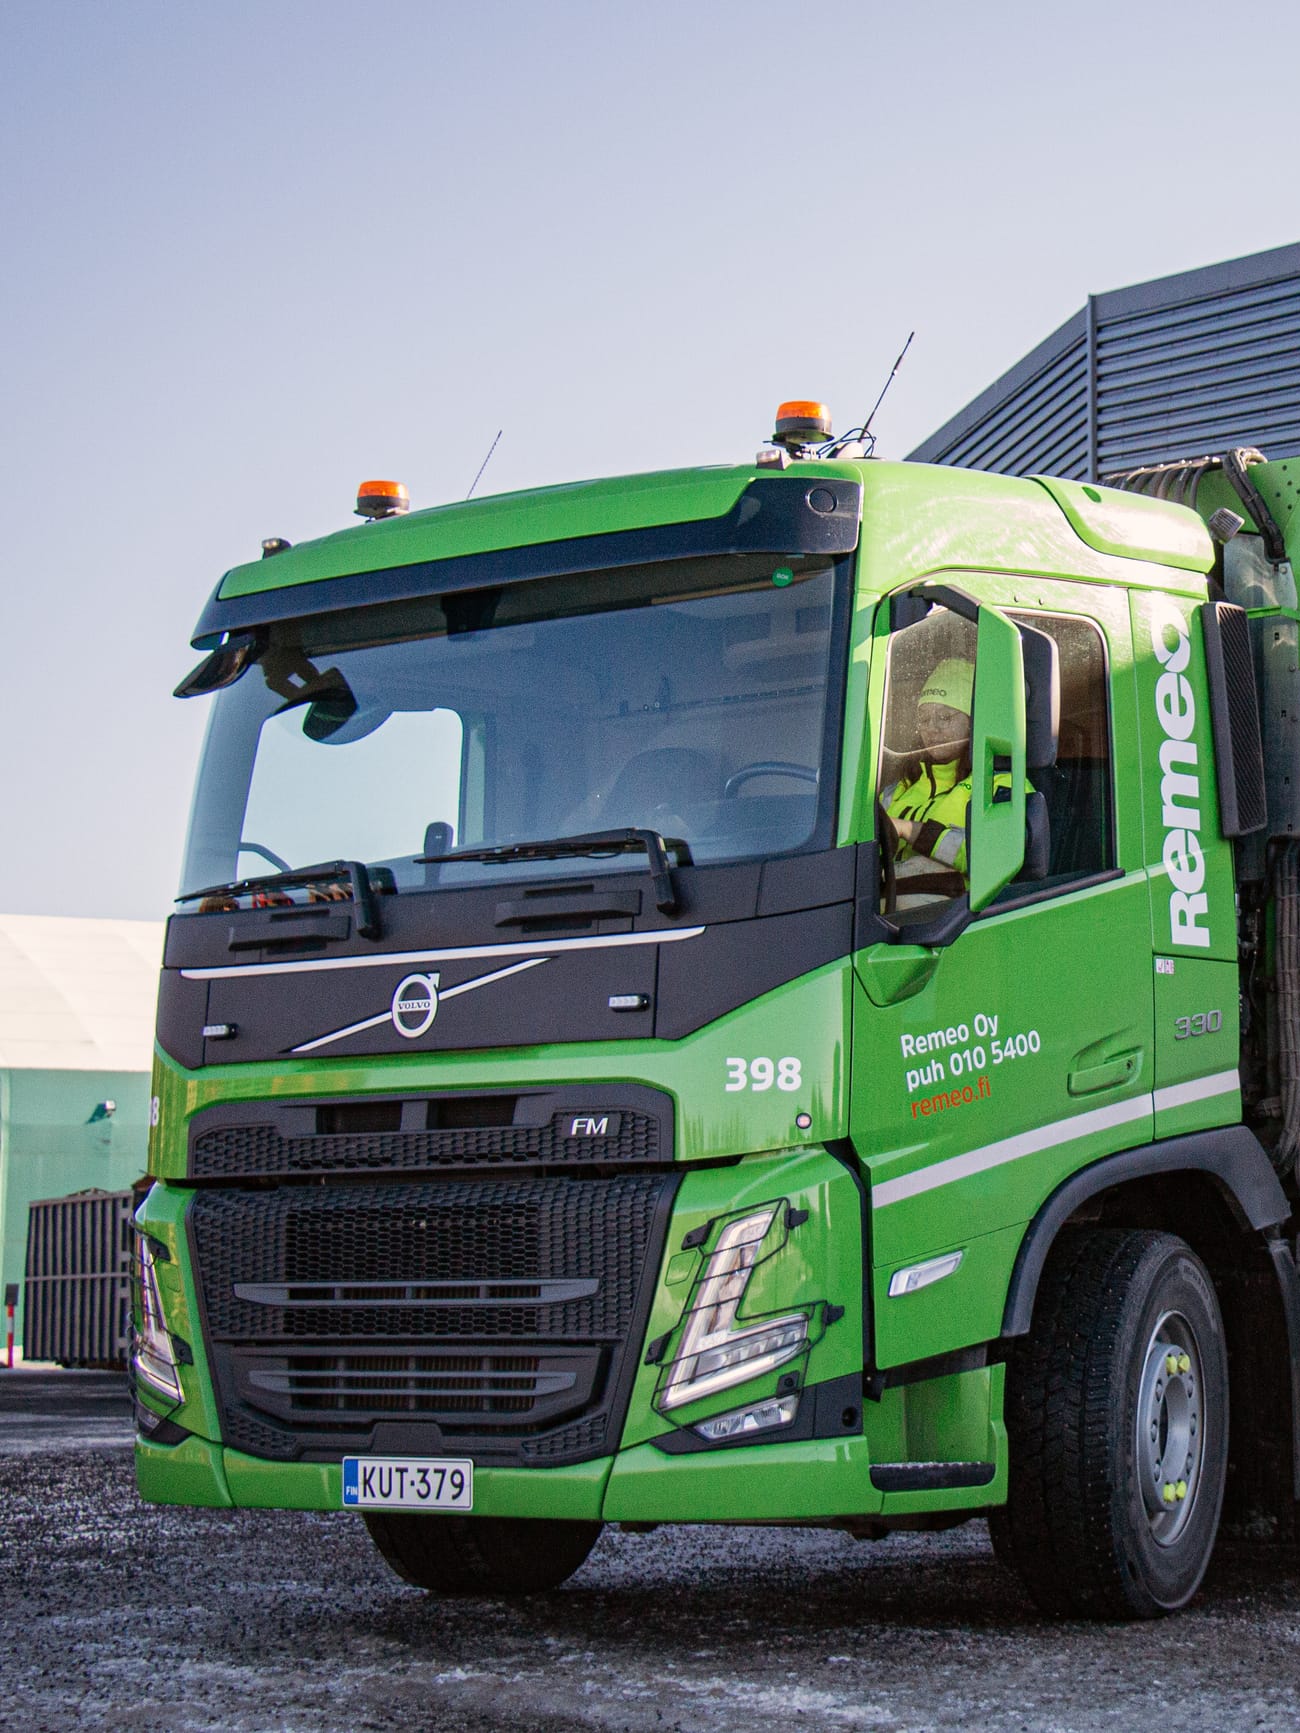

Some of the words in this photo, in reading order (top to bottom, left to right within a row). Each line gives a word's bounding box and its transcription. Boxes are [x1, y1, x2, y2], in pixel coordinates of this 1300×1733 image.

[1150, 602, 1211, 948] Remeo
[398, 1001, 431, 1010] VOLVO
[900, 1024, 970, 1058] Remeo
[974, 1013, 998, 1037] Oy
[1174, 1009, 1222, 1041] 330
[725, 1056, 802, 1092] 398
[906, 1059, 945, 1093] puh
[949, 1046, 986, 1076] 010
[991, 1030, 1041, 1064] 5400
[911, 1075, 992, 1120] remeo.fi
[571, 1117, 609, 1136] FM
[345, 1486, 358, 1496] FIN
[362, 1466, 465, 1500] KUT-379
